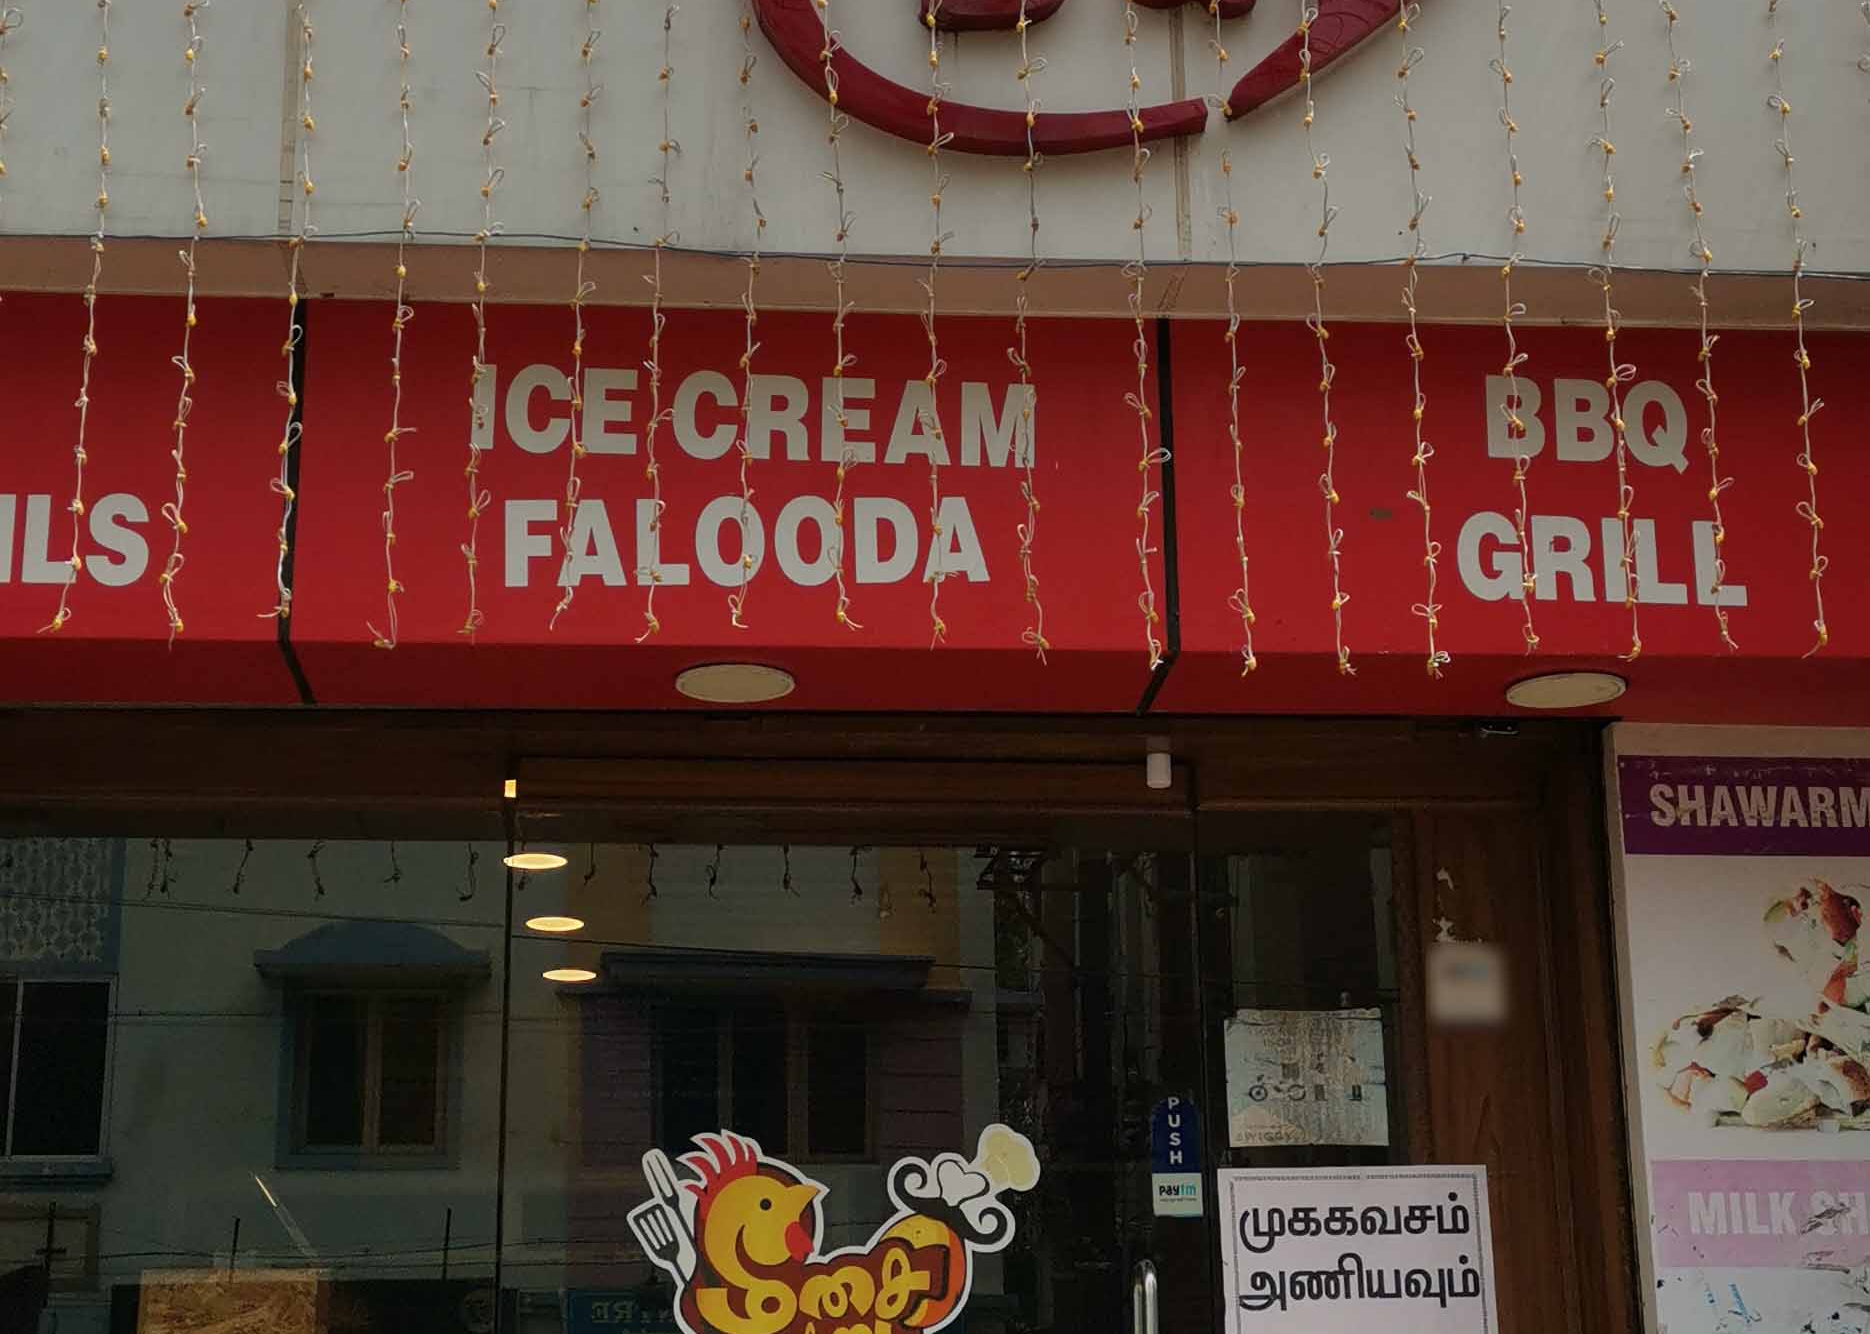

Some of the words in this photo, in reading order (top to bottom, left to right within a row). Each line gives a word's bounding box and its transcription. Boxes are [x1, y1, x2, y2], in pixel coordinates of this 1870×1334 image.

[475, 364, 638, 456] ICE
[671, 369, 1037, 469] CREAM
[1485, 374, 1689, 474] BBQ
[502, 494, 992, 588] FALOODA
[1456, 510, 1749, 607] GRILL
[1649, 783, 1870, 828] SHAWARM
[1167, 1096, 1183, 1164] PUSH
[1239, 1191, 1471, 1254] முககவசம்
[1687, 1190, 1798, 1235] MILK
[1238, 1252, 1481, 1312] அணியவும்
